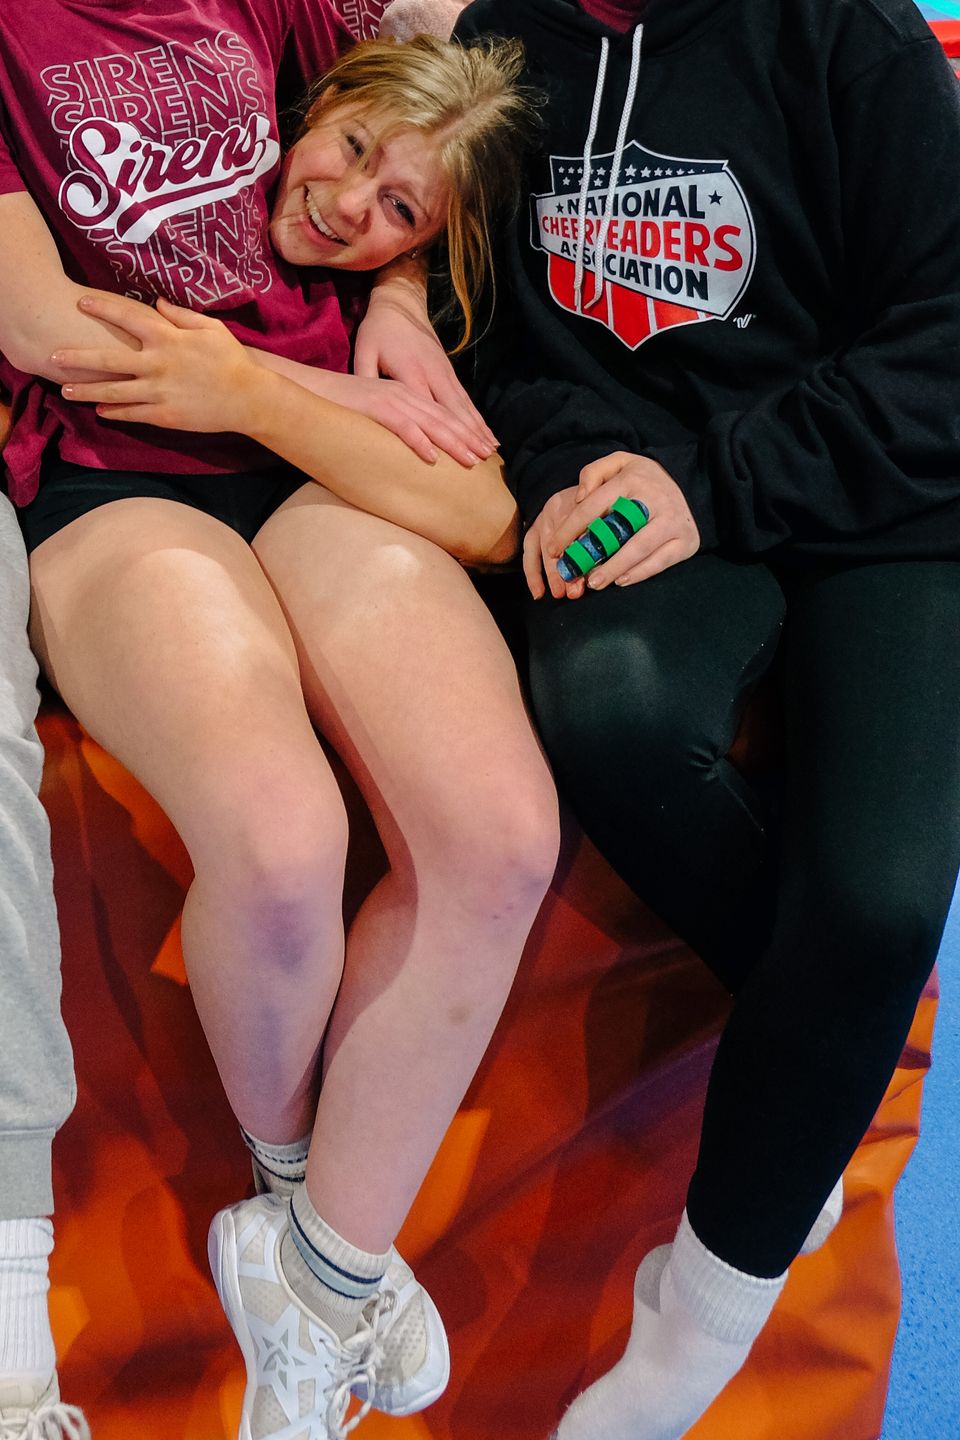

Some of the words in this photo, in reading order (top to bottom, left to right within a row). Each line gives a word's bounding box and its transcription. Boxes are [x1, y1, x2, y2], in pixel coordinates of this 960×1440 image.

[40, 29, 255, 106] SIRENS
[50, 66, 268, 137] SIRENS
[57, 111, 281, 244] Sirens
[566, 184, 706, 220] NATIONAL
